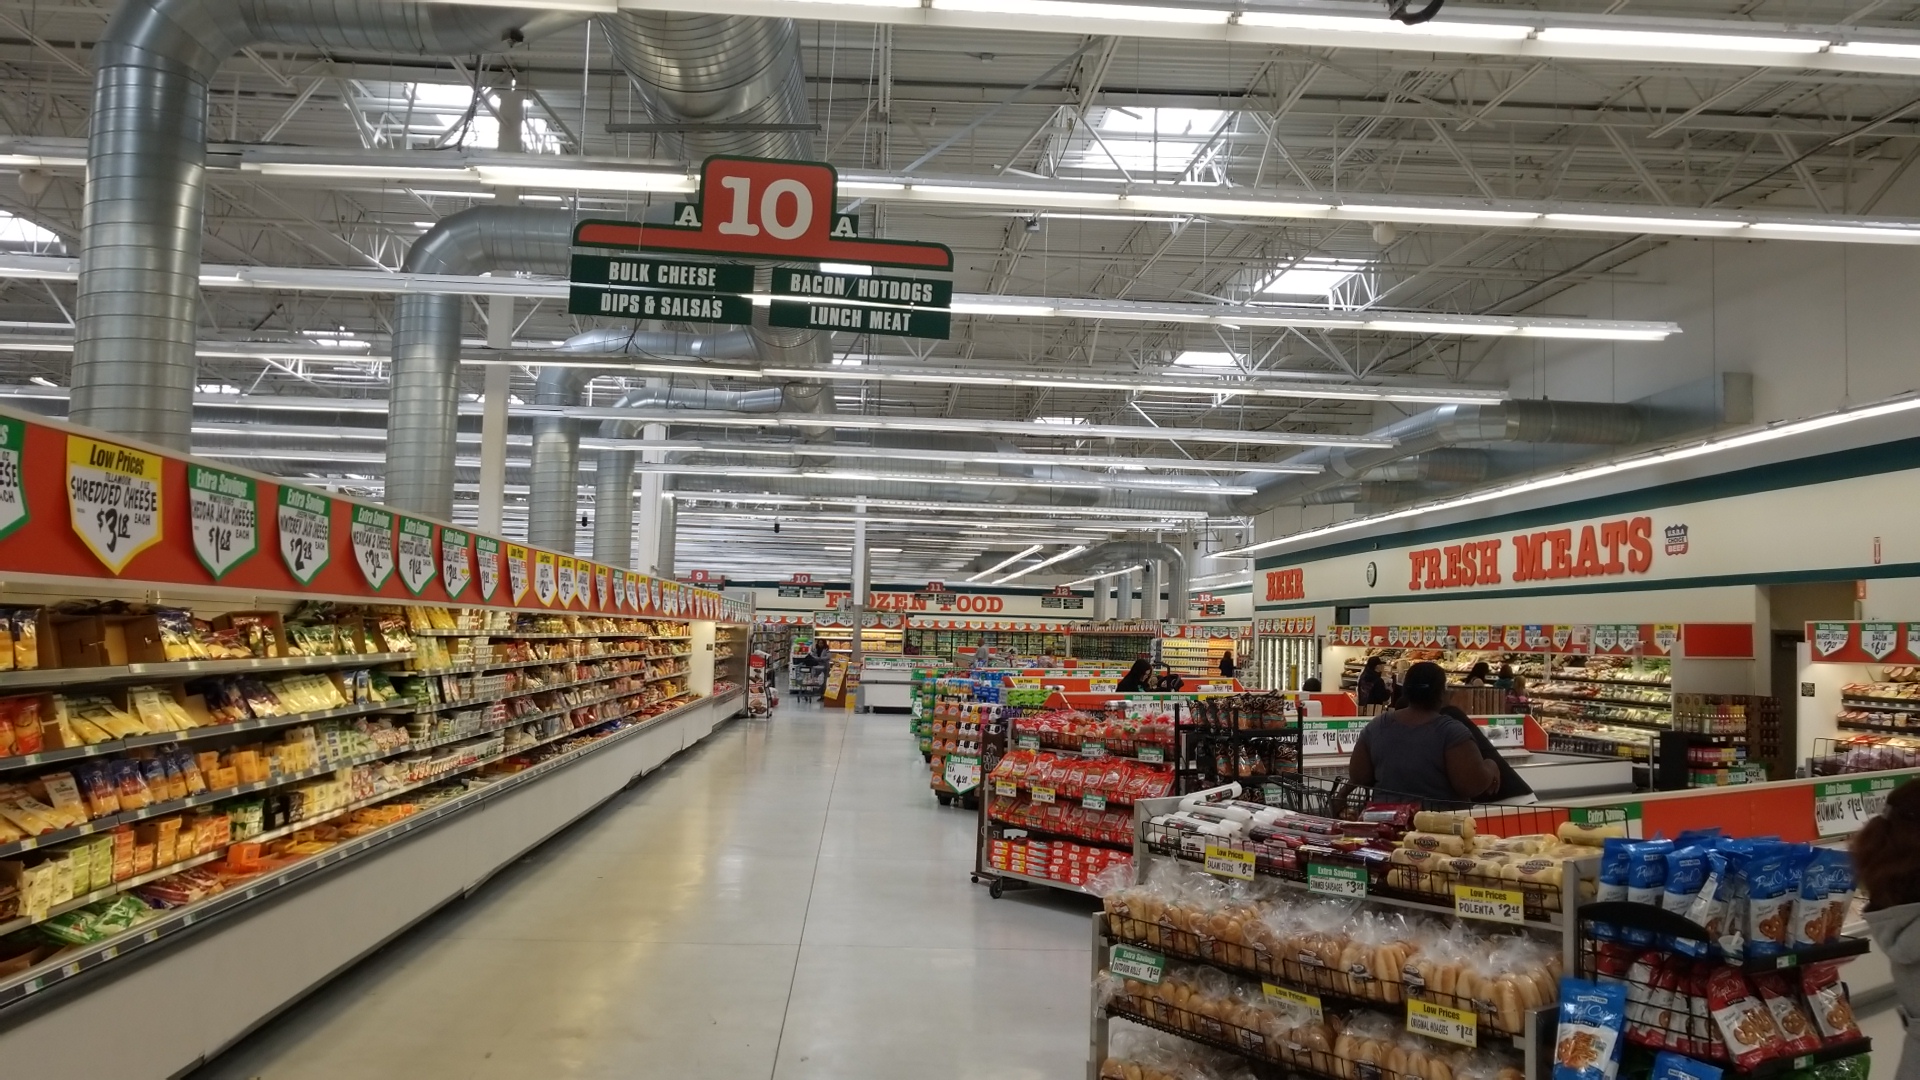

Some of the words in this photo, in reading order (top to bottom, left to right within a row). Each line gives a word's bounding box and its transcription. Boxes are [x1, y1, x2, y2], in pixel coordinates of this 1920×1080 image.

[676, 205, 702, 227] A
[718, 175, 813, 240] 10
[831, 216, 857, 238] A
[609, 261, 649, 283] BULK
[658, 265, 716, 287] CHEESE
[790, 273, 933, 303] BACON/HOTDOGS
[601, 293, 640, 314] DIPS
[644, 296, 655, 315] &
[660, 297, 722, 320] SALSAS
[810, 305, 861, 329] LUNCH
[869, 310, 911, 332] MEAT
[89, 444, 115, 469] Low
[115, 450, 144, 475] Prices
[196, 468, 217, 490] Extra
[218, 474, 247, 498] Savings
[70, 476, 121, 507] SHREDDED
[124, 486, 157, 512] CHEESE
[287, 488, 305, 508] Extra
[134, 513, 150, 525] EACH
[216, 504, 230, 524] JACK
[231, 507, 254, 528] CHEESE
[236, 529, 249, 540] EACH
[1668, 536, 1685, 544] CHOICE
[1408, 539, 1501, 591] FRESH
[1513, 516, 1653, 582] MEATS
[1668, 544, 1685, 553] BEEF
[696, 572, 703, 580] 9
[796, 575, 808, 583] 10
[1266, 567, 1305, 601] BEER
[930, 583, 941, 591] 11
[1058, 588, 1068, 596] 12
[1200, 594, 1210, 602] 13
[1817, 801, 1844, 822] HUMMUS
[1318, 866, 1332, 875] Extra
[1333, 868, 1357, 879] Savings
[1470, 889, 1483, 898] Low
[1485, 890, 1507, 900] Prices
[1459, 902, 1495, 915] POLENTA
[1123, 950, 1135, 960] Extra
[1136, 953, 1156, 964] Savings
[1423, 1004, 1437, 1015] Low
[1439, 1007, 1460, 1020] Prices
[1411, 1017, 1429, 1031] ORIGINAL
[1430, 1021, 1448, 1036] HOAGIES
